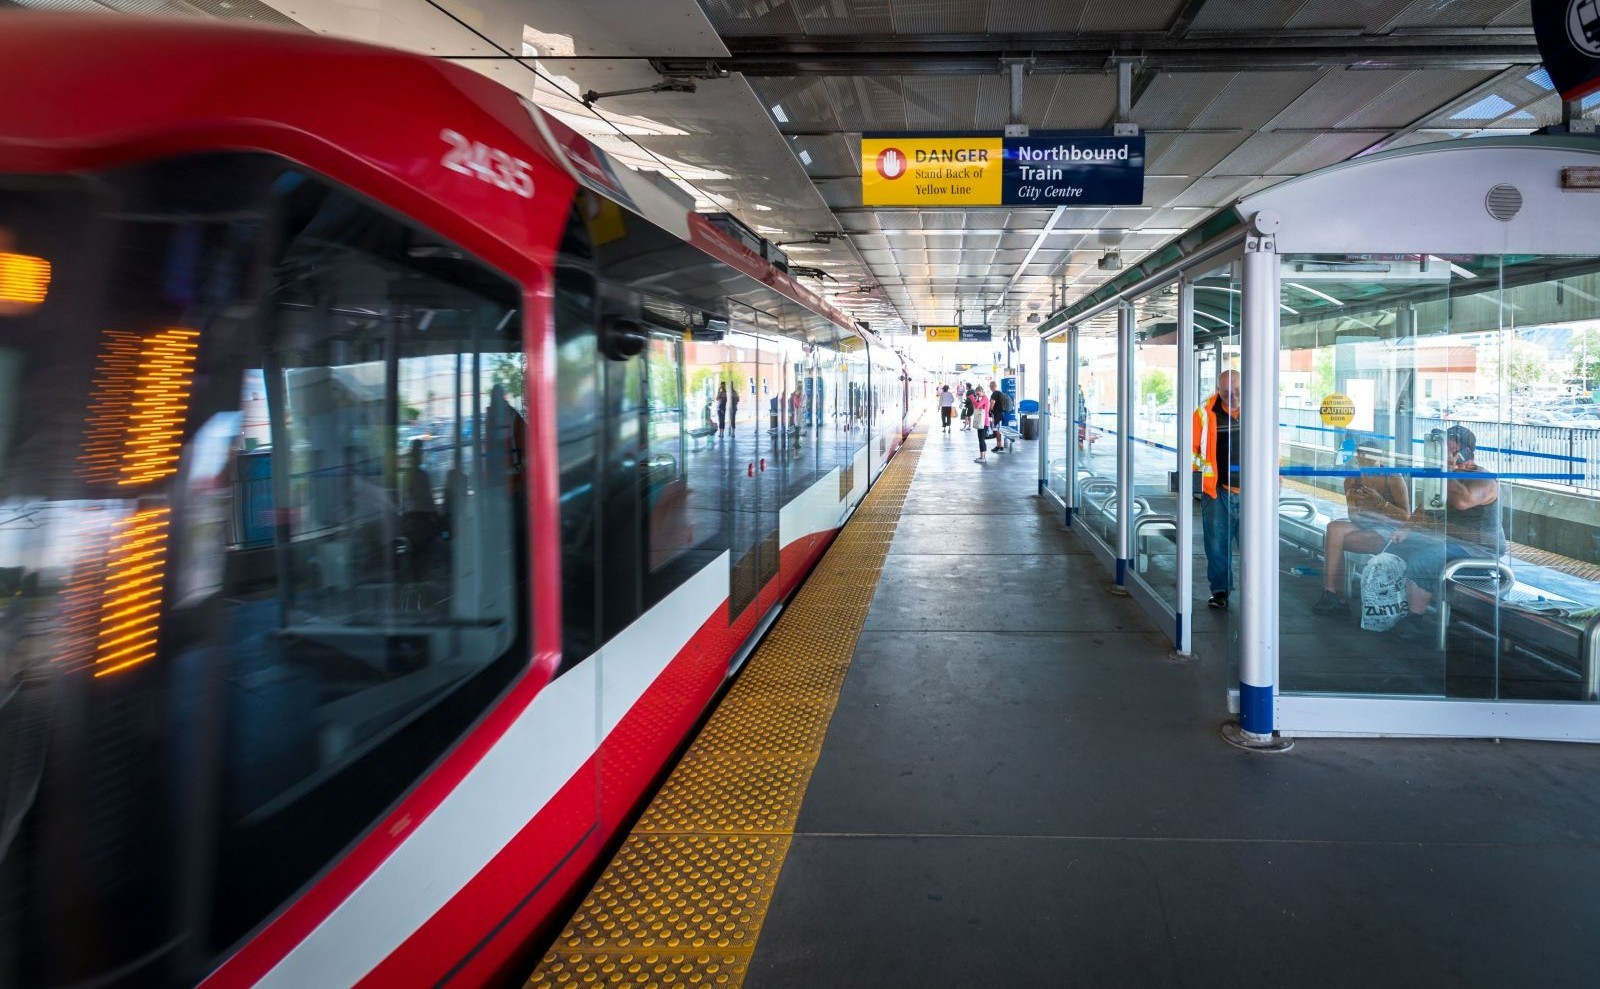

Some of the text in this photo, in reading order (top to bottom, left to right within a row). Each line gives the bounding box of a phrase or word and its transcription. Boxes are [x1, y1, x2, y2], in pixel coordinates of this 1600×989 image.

[915, 149, 988, 163] DANGER
[1018, 144, 1129, 161] Northbound
[440, 128, 535, 199] 2435
[915, 168, 984, 179] Stand Back of
[1019, 165, 1063, 181] Train
[915, 184, 972, 195] Yellow Line
[1018, 185, 1083, 200] City Centre
[1321, 407, 1354, 415] CAUTION
